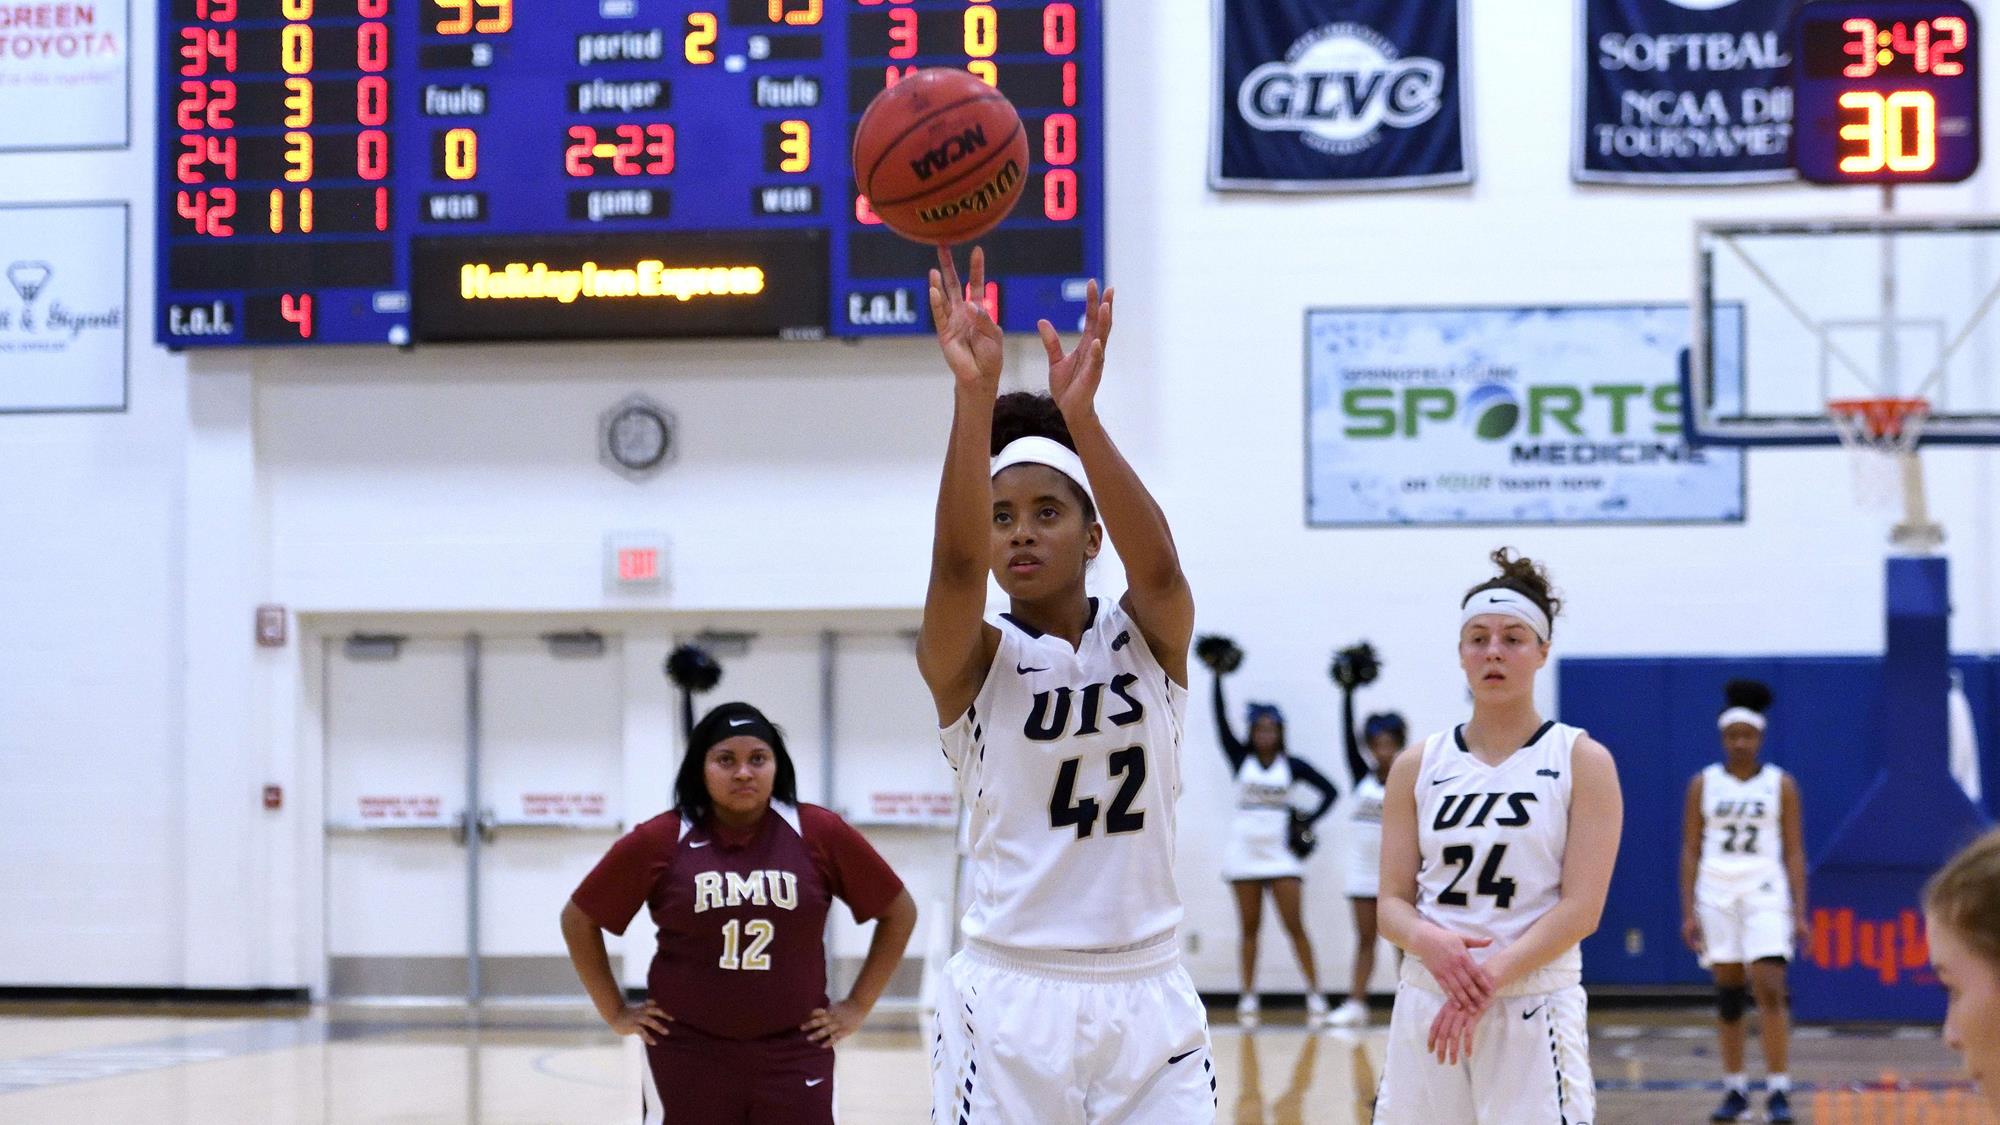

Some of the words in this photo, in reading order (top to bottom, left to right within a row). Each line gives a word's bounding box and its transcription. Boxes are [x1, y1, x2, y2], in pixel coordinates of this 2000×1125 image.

[180, 26, 237, 76] 34
[282, 23, 313, 74] 0
[357, 22, 388, 72] 0
[579, 28, 661, 66] period
[685, 12, 717, 64] 2
[888, 8, 918, 59] 3
[964, 5, 997, 58] 0
[1043, 3, 1076, 55] 0
[1842, 17, 1968, 77] 3:42
[178, 80, 237, 129] 22
[284, 77, 313, 128] 3
[357, 76, 388, 126] 0
[426, 84, 485, 115] fouls
[578, 78, 661, 113] player
[756, 75, 819, 107] fouls
[1062, 61, 1076, 107] 1
[1246, 62, 1436, 124] GLVC
[1621, 88, 1730, 126] NCAA
[178, 134, 237, 183] 24
[284, 131, 313, 182] 3
[357, 129, 388, 180] 0
[445, 128, 477, 180] 0
[566, 124, 674, 176] 2-23
[780, 120, 810, 172] 3
[910, 123, 987, 181] NCAA
[1044, 113, 1077, 165] 0
[1839, 91, 1936, 172] 30
[177, 187, 237, 237] 42
[269, 187, 313, 233] 11
[375, 186, 388, 231] 1
[430, 194, 478, 219] won
[588, 189, 652, 222] game
[762, 187, 812, 212] won
[1044, 169, 1077, 220] 0
[281, 293, 312, 338] 4
[1023, 672, 1145, 743] UIS
[1049, 742, 1147, 842] 42
[1433, 792, 1539, 832] UIS
[1722, 824, 1758, 854] 22
[694, 870, 799, 913] RMU
[1436, 842, 1519, 909] 24
[719, 919, 774, 971] 12
